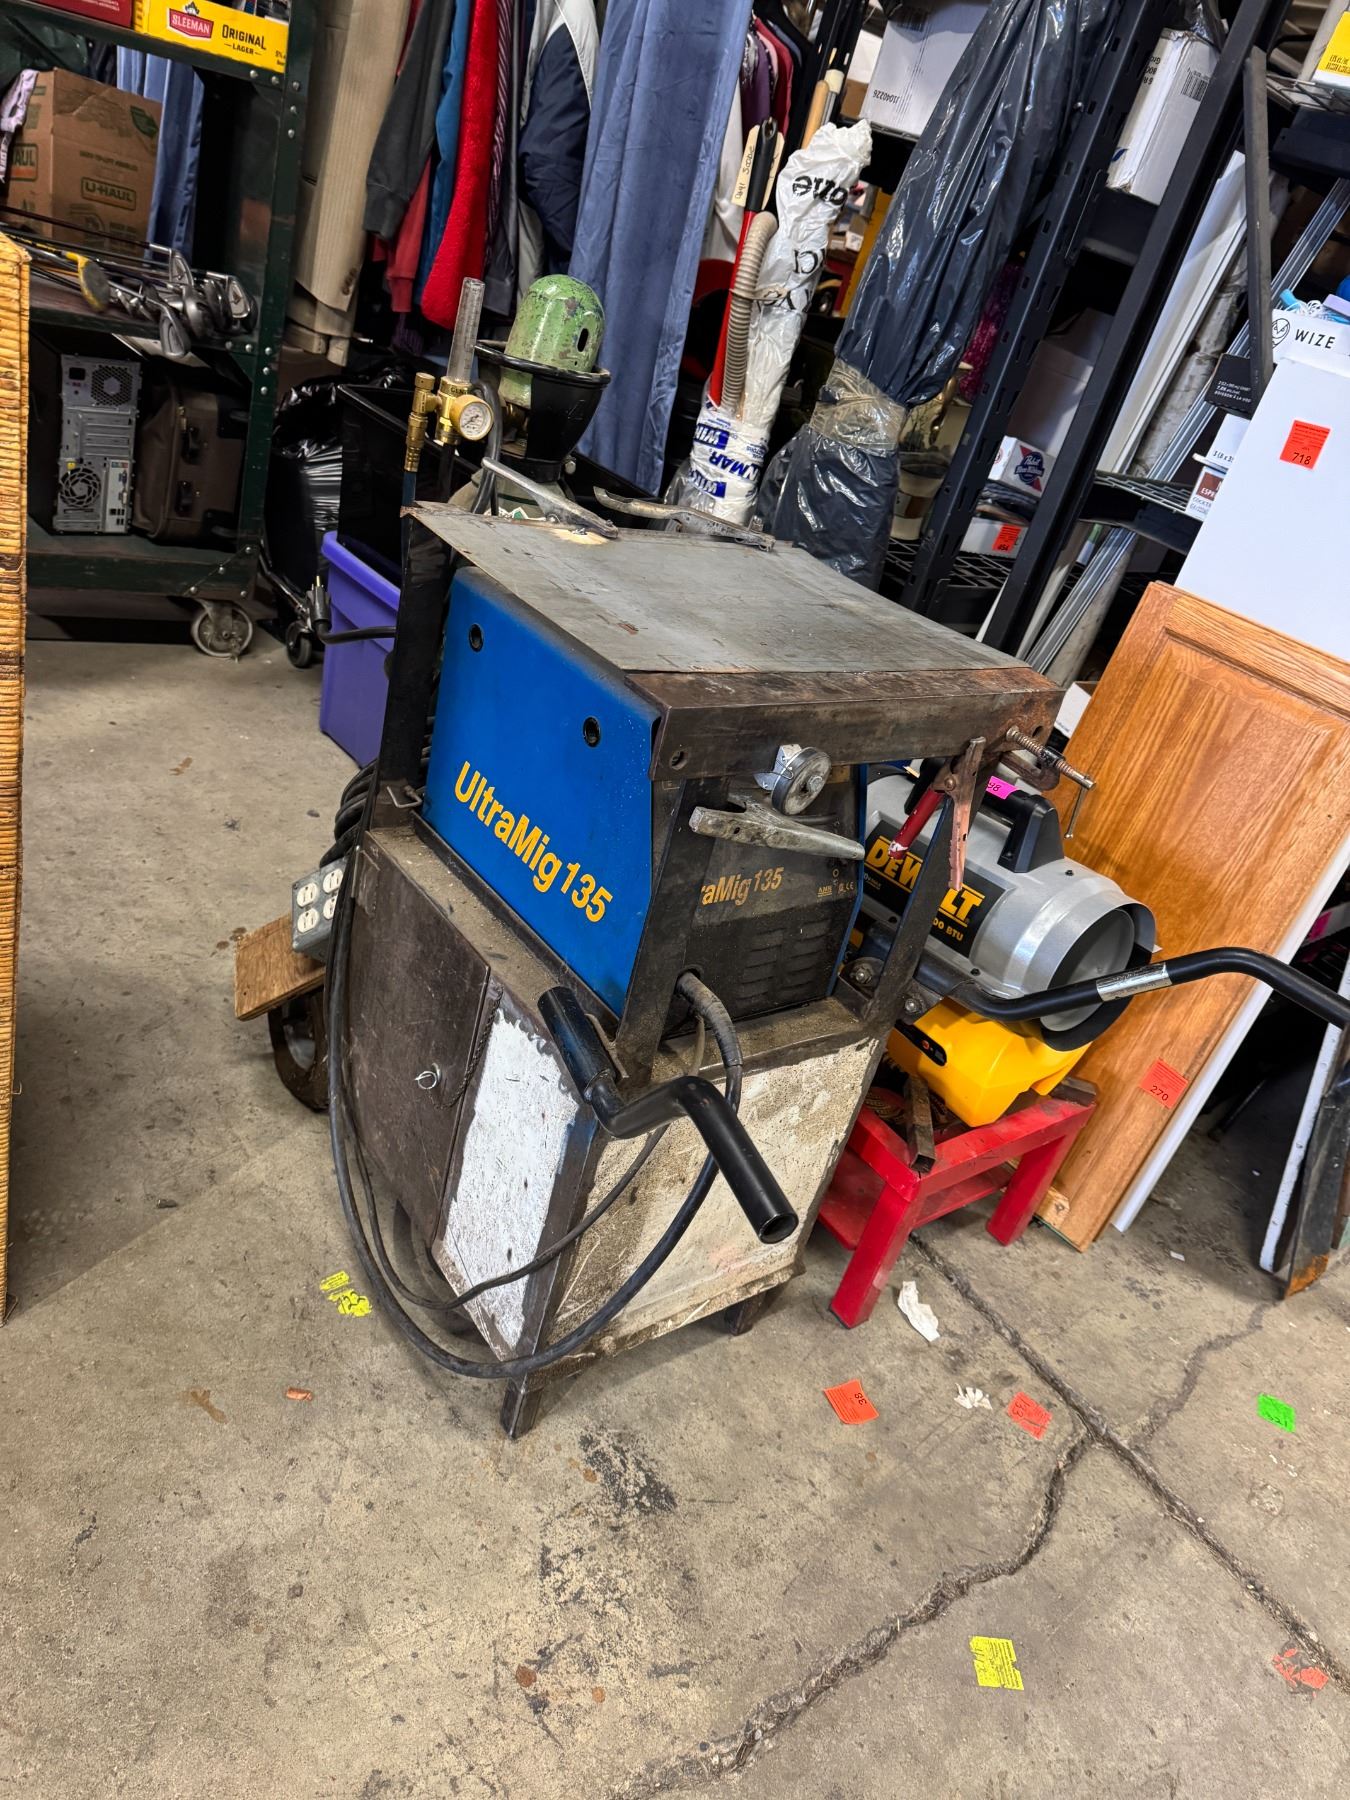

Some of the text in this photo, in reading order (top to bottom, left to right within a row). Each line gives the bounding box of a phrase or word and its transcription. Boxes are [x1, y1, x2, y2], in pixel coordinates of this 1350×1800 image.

[172, 14, 210, 34] SLEEMAN
[222, 24, 267, 50] ORIGINAL
[232, 43, 254, 55] LAGER
[84, 182, 133, 202] U-HAUL
[1295, 329, 1336, 349] WIZE
[1292, 451, 1312, 465] 718
[454, 760, 613, 922] UltraMig 135
[754, 867, 785, 892] 135
[866, 838, 983, 922] DEWLT
[946, 926, 964, 941] BTU
[1150, 1085, 1169, 1101] 270
